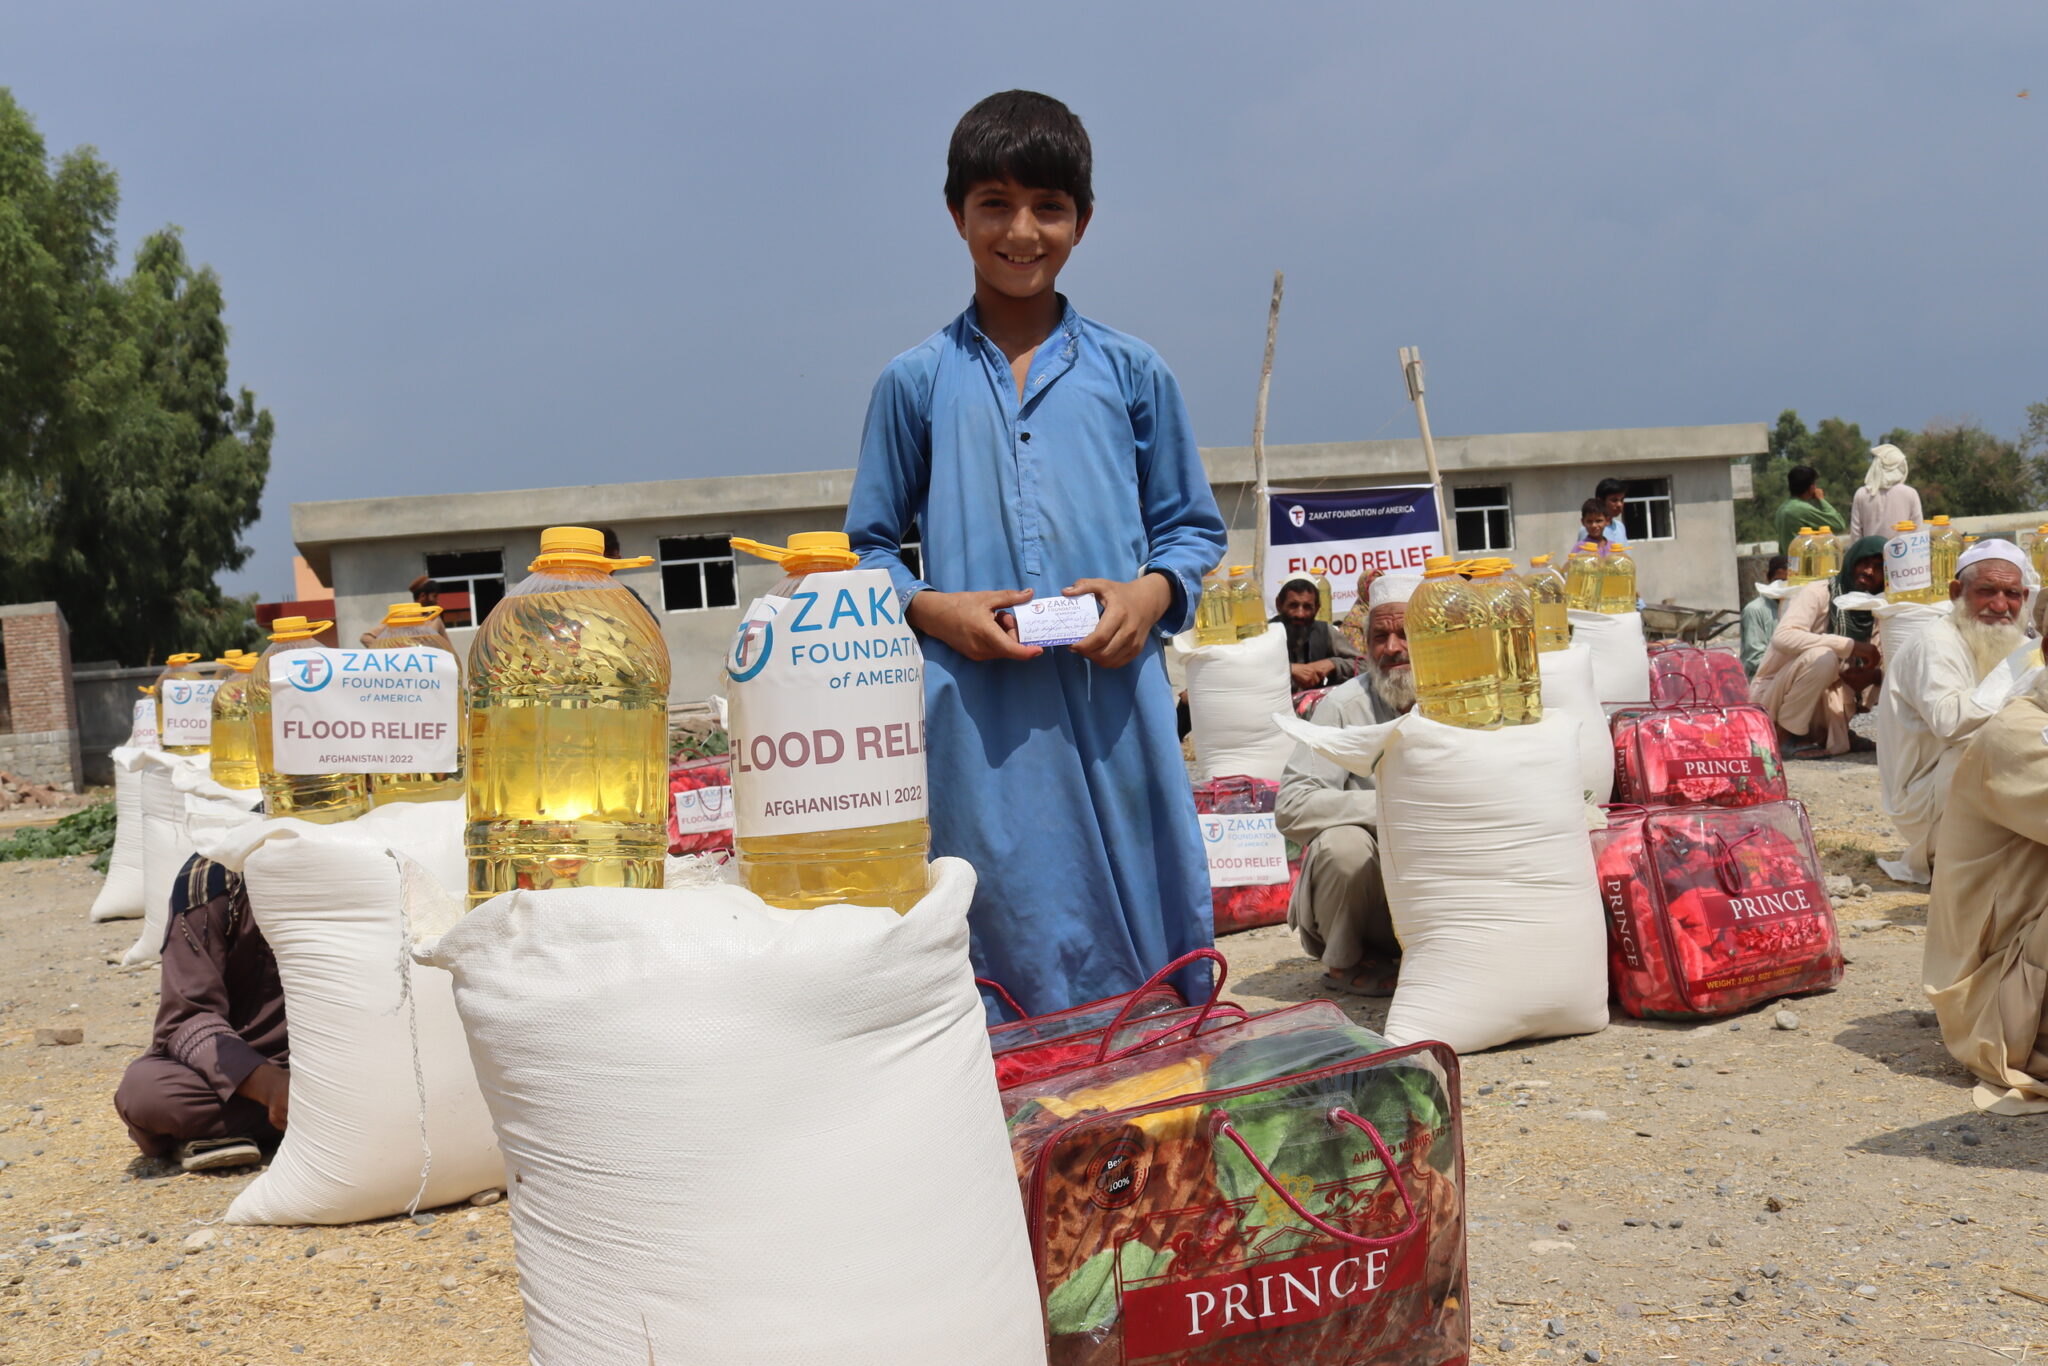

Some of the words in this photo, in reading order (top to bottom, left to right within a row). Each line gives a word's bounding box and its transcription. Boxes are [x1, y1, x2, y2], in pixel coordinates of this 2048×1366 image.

[1308, 511, 1332, 521] ZAKAT
[1332, 508, 1377, 519] FOUNDATION
[1377, 507, 1385, 516] of
[1385, 505, 1415, 515] AMERICA
[1890, 566, 1925, 579] FLOOD
[1331, 589, 1357, 600] FGHAN
[790, 586, 904, 633] ZAK
[1047, 599, 1079, 609] ZAKAT
[341, 653, 438, 673] ZAKAT
[342, 677, 441, 690] FOUNDATION
[829, 671, 851, 689] of
[856, 667, 920, 687] AMERICA
[359, 693, 373, 703] of
[373, 694, 423, 703] AMERICA
[166, 718, 208, 729] FLOOD
[283, 720, 366, 740] FLOOD
[371, 722, 448, 740] RELIEF
[855, 720, 925, 761] RELI
[318, 754, 384, 764] AFGHANISTAN
[389, 754, 414, 764] 2022
[1684, 760, 1752, 776] PRINCE
[764, 791, 882, 818] AFGHANISTAN
[894, 785, 922, 804] 2022
[1227, 818, 1274, 831] ZAKAT
[1209, 857, 1242, 869] LOOD
[1244, 856, 1282, 868] RELIEF
[1728, 889, 1811, 920] PRINCE
[1607, 880, 1639, 967] PRINCE
[1352, 1143, 1397, 1166] AHMD
[1108, 1176, 1131, 1193] 100%
[1185, 1248, 1389, 1336] PRINCE
